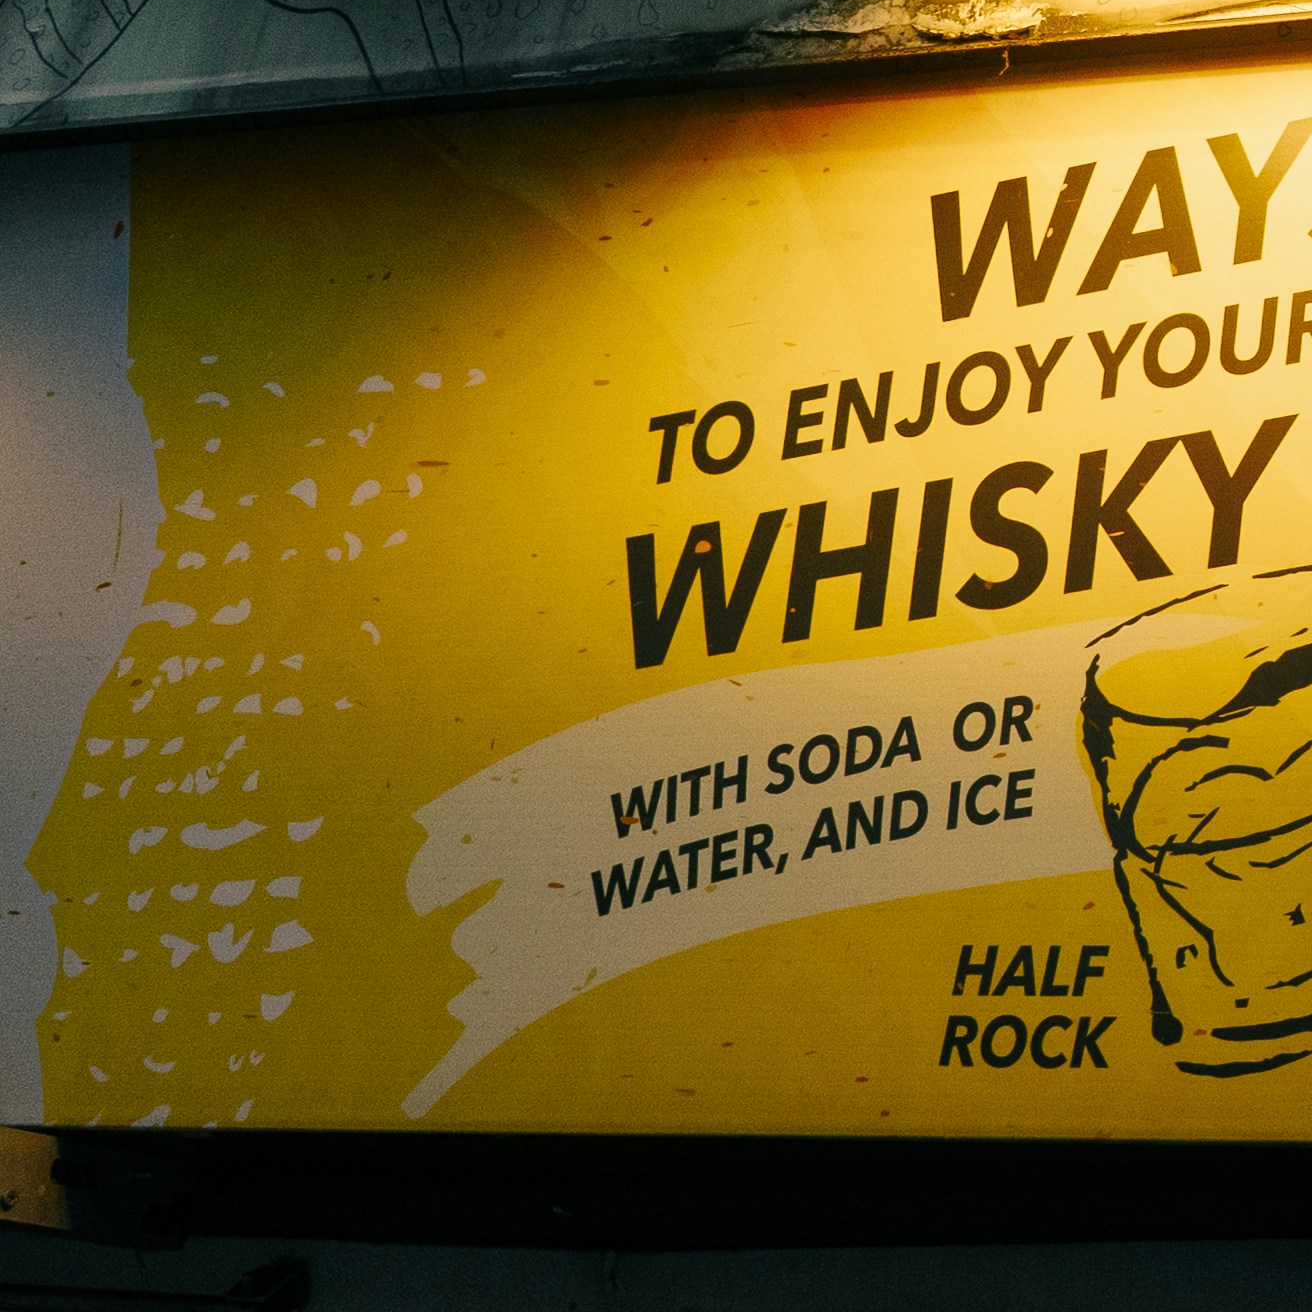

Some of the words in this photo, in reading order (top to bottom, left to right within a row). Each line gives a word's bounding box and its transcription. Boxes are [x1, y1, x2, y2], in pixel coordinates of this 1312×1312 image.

[648, 400, 755, 485] TO
[781, 336, 1074, 461] ENJOY
[625, 414, 1299, 671] WHISKY
[611, 755, 748, 838] WITH
[765, 716, 922, 795] SODA
[953, 696, 1034, 753] OR
[591, 824, 789, 917] WATER,
[801, 790, 929, 861] AND
[946, 769, 1036, 831] ICE
[939, 1015, 1117, 1070] ROCK
[952, 945, 1111, 997] HALF
